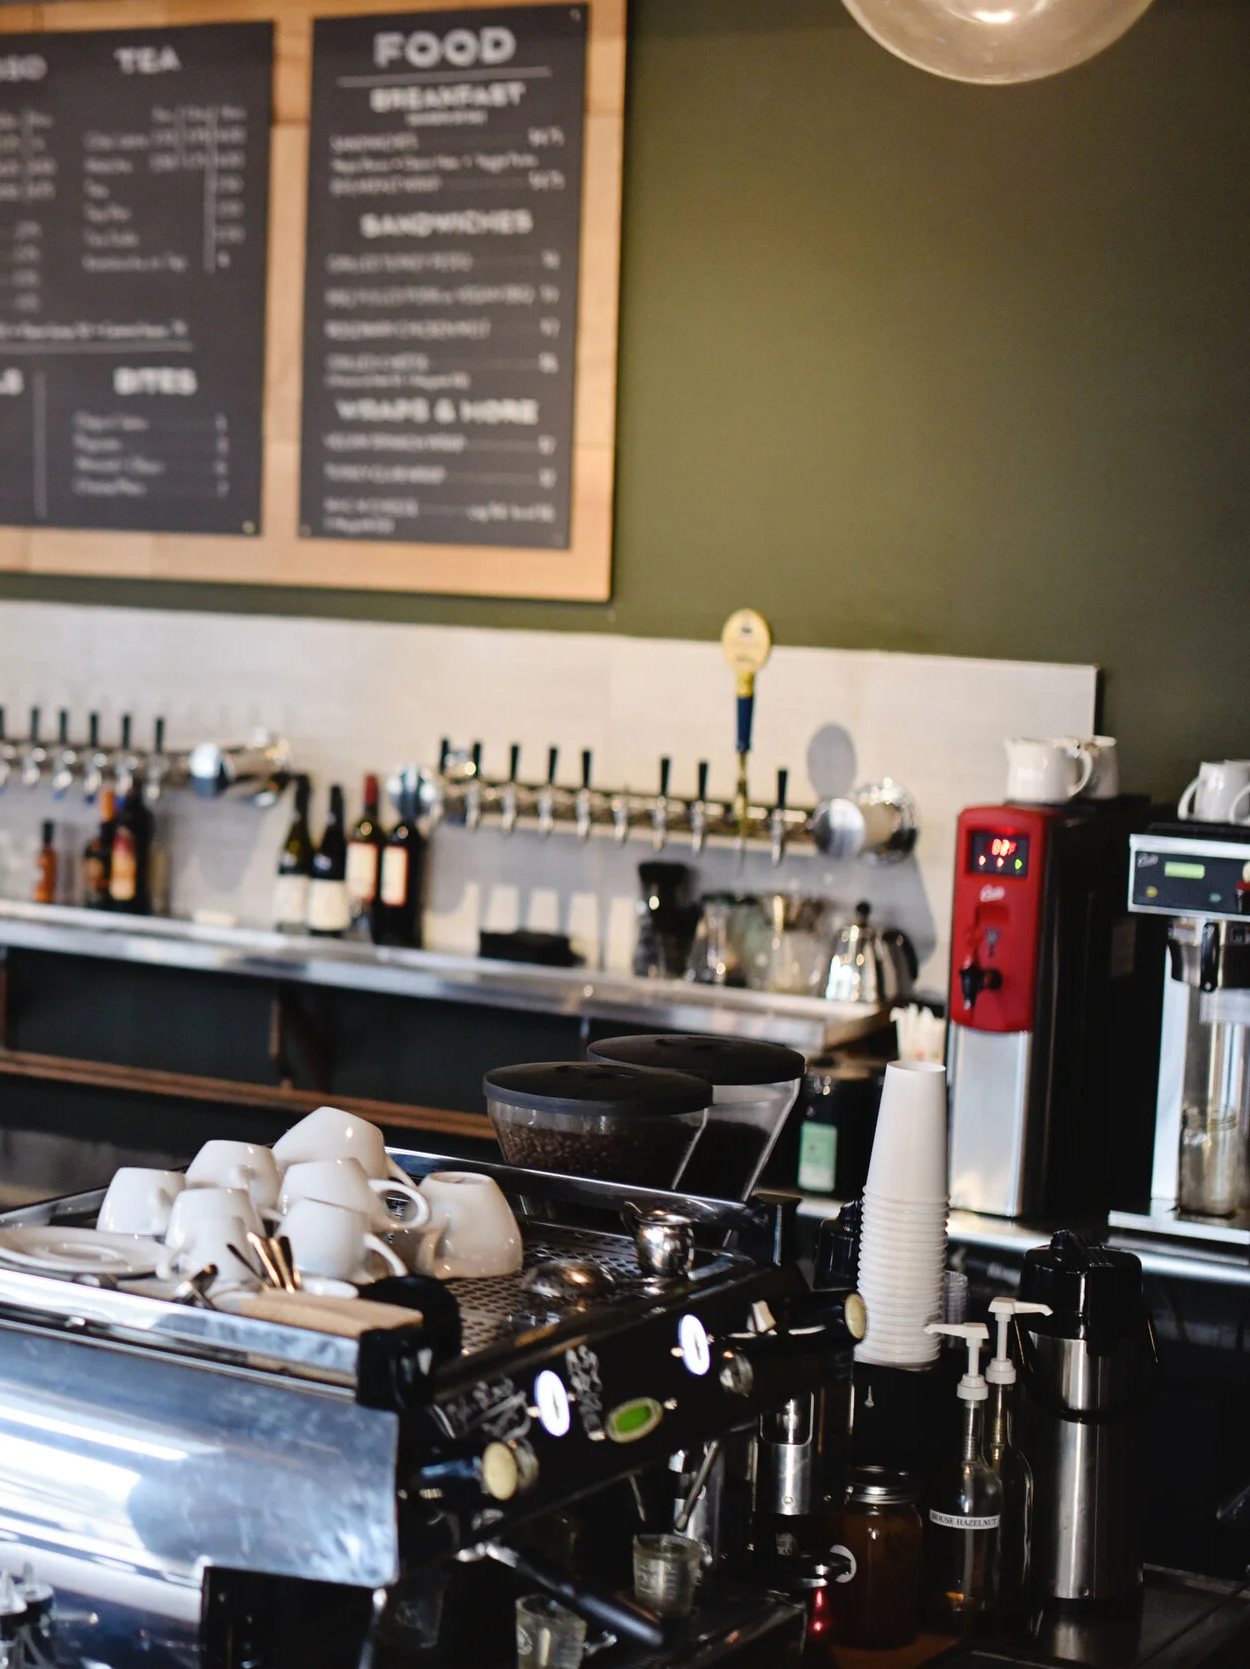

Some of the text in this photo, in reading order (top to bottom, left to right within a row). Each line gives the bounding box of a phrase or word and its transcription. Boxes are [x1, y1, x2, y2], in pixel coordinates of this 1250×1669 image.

[114, 46, 181, 75] TEA
[373, 26, 516, 68] FOOD
[370, 81, 526, 113] BREAKFAST
[360, 208, 533, 238] SANDWICHES
[114, 366, 197, 396] BITES
[956, 1518, 996, 1527] HAZELNUT
